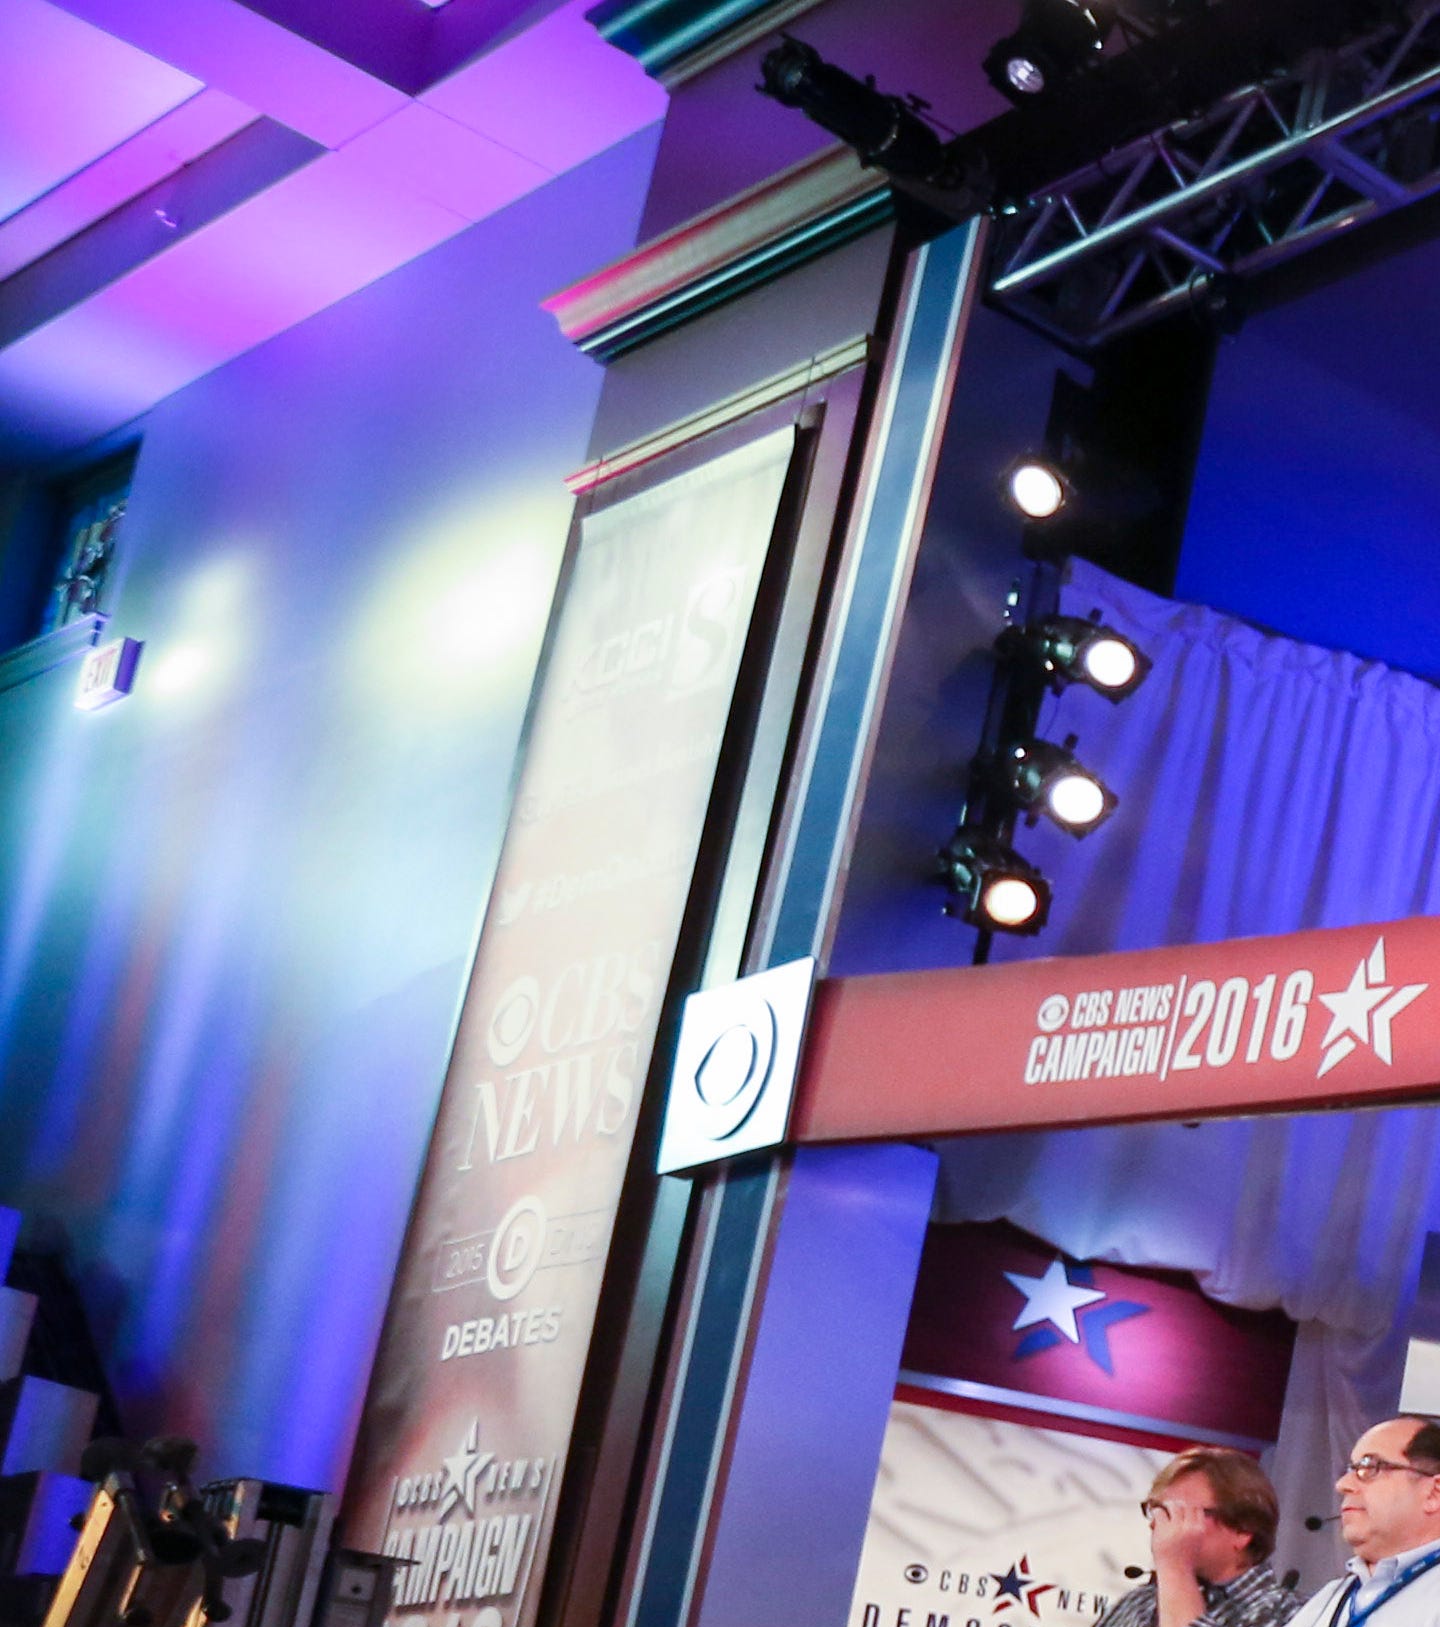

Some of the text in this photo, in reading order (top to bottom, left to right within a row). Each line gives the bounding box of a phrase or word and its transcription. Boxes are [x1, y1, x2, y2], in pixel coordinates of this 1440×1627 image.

[538, 938, 666, 1055] CBS
[1071, 983, 1175, 1030] CBS NEWS
[1172, 970, 1315, 1070] 2016
[1024, 1026, 1166, 1085] CAMPAIGN
[457, 1040, 642, 1172] NEWS
[440, 1306, 563, 1361] DEBATES
[940, 1570, 1110, 1615] CBS NEW
